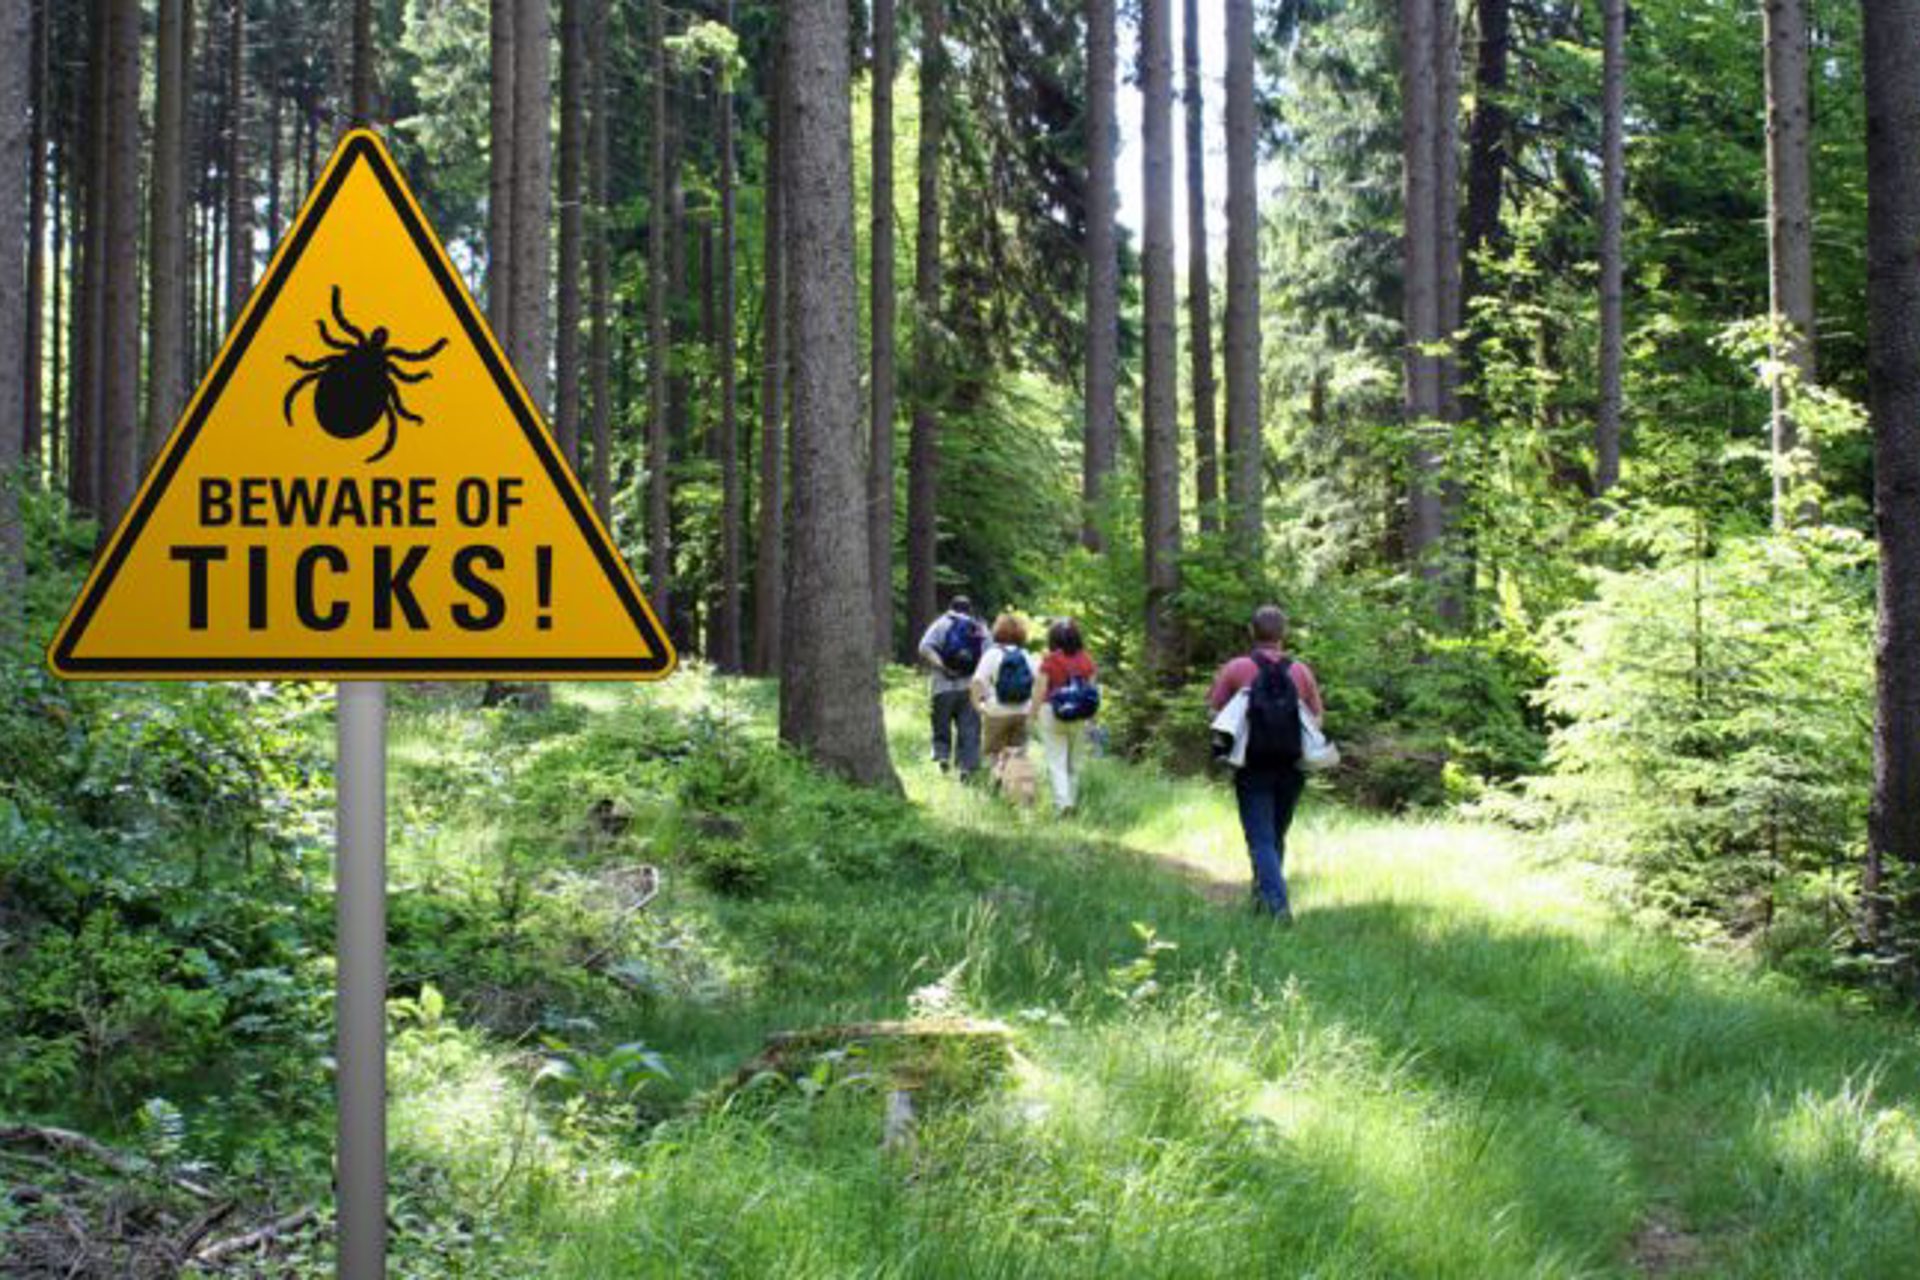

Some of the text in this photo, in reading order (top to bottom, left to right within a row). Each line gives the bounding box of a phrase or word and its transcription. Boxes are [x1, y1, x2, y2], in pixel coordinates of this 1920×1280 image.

[199, 477, 523, 528] BEWARE OF
[170, 544, 553, 632] TICKS!
